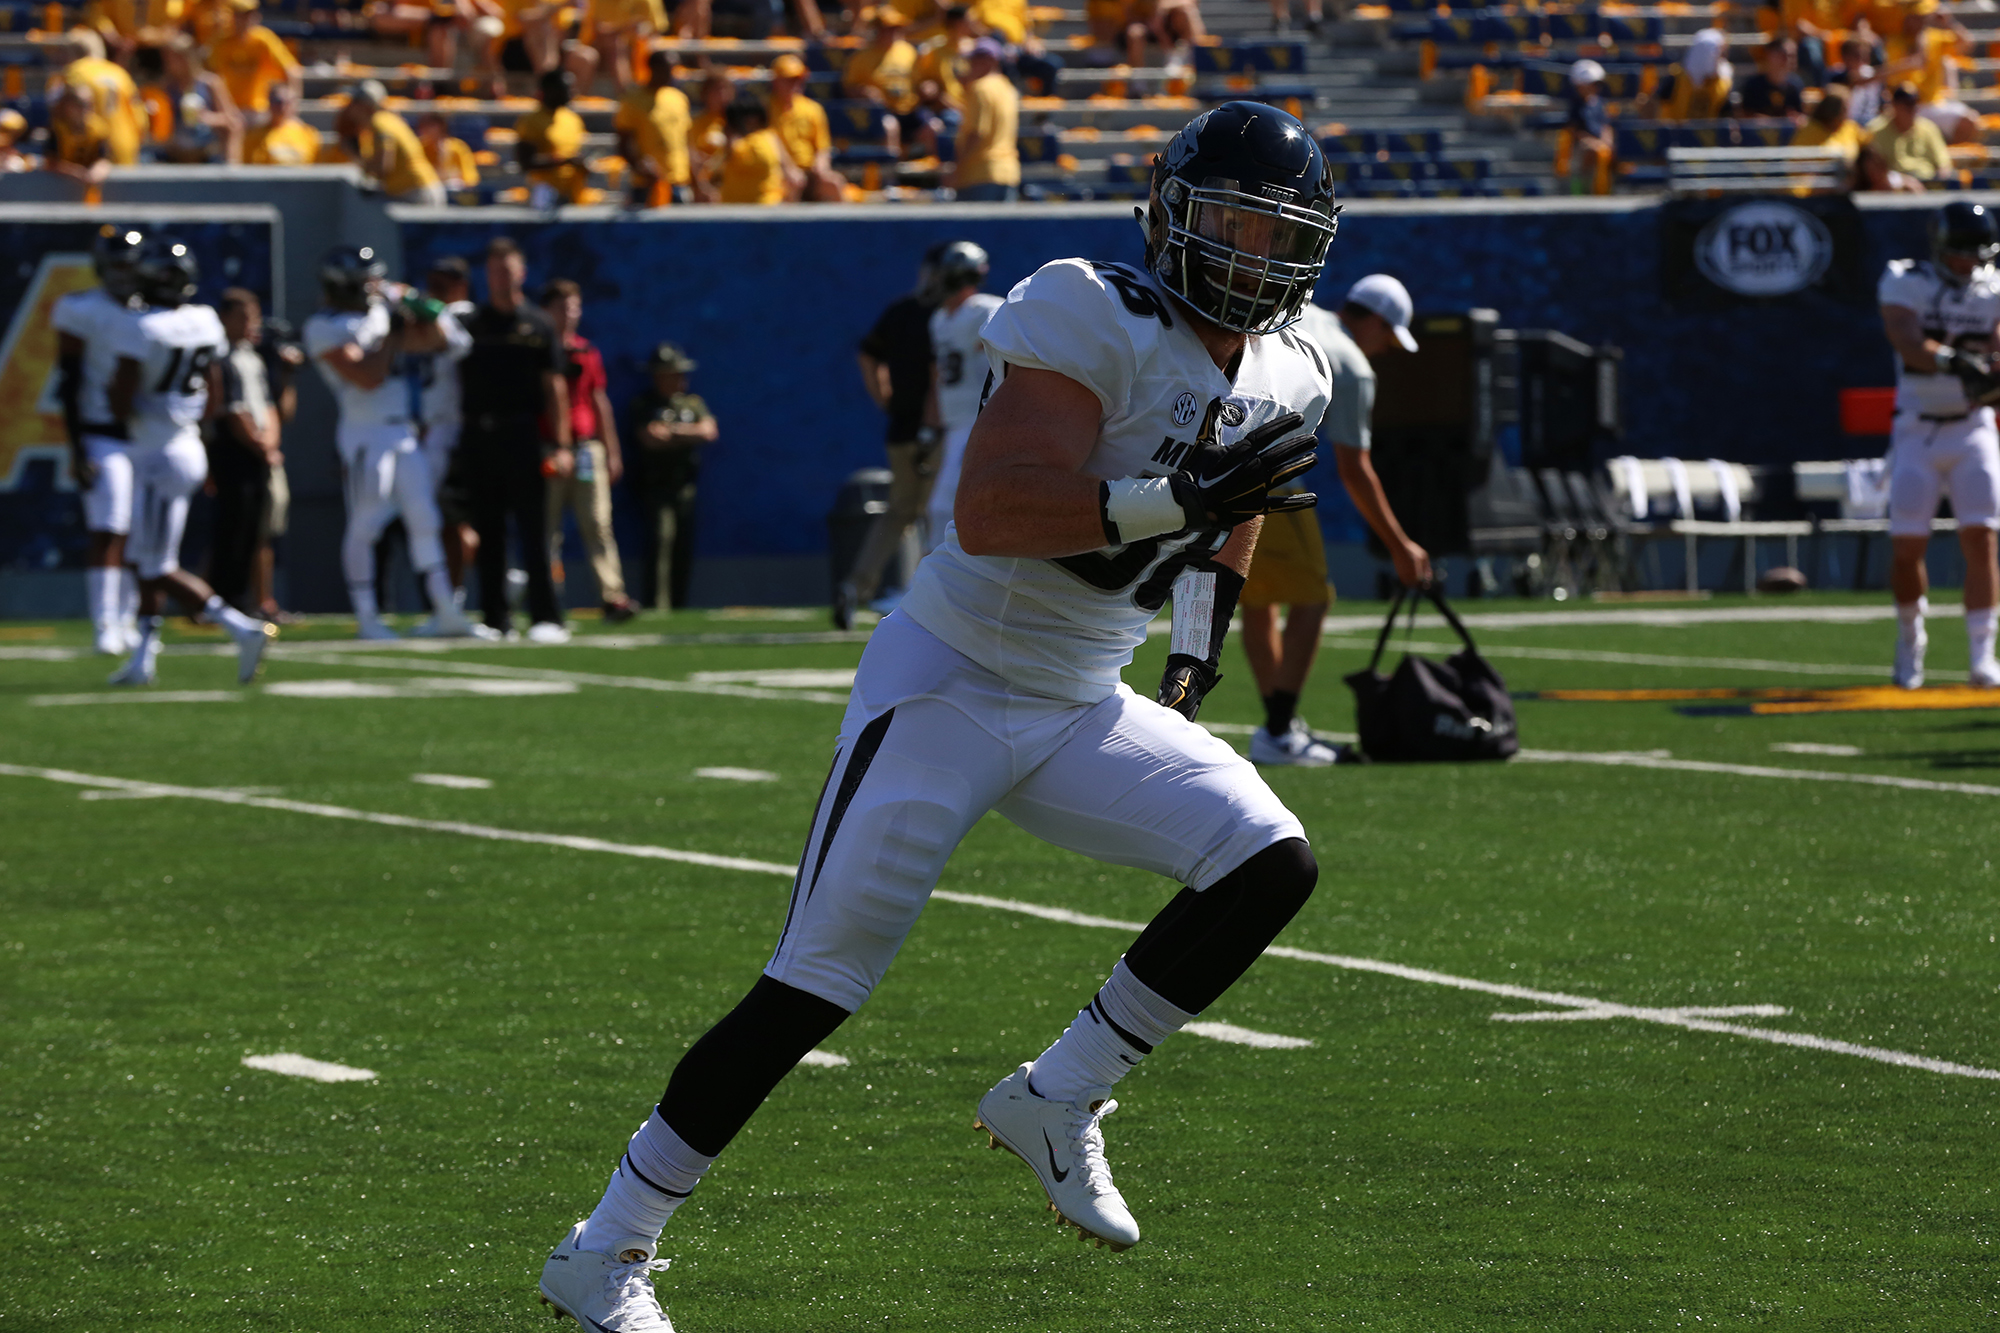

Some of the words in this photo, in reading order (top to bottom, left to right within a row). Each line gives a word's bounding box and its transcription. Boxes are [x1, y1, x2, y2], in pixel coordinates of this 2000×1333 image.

[1260, 186, 1295, 202] TIGERS
[1729, 222, 1797, 256] FOX
[1174, 393, 1196, 424] SEC
